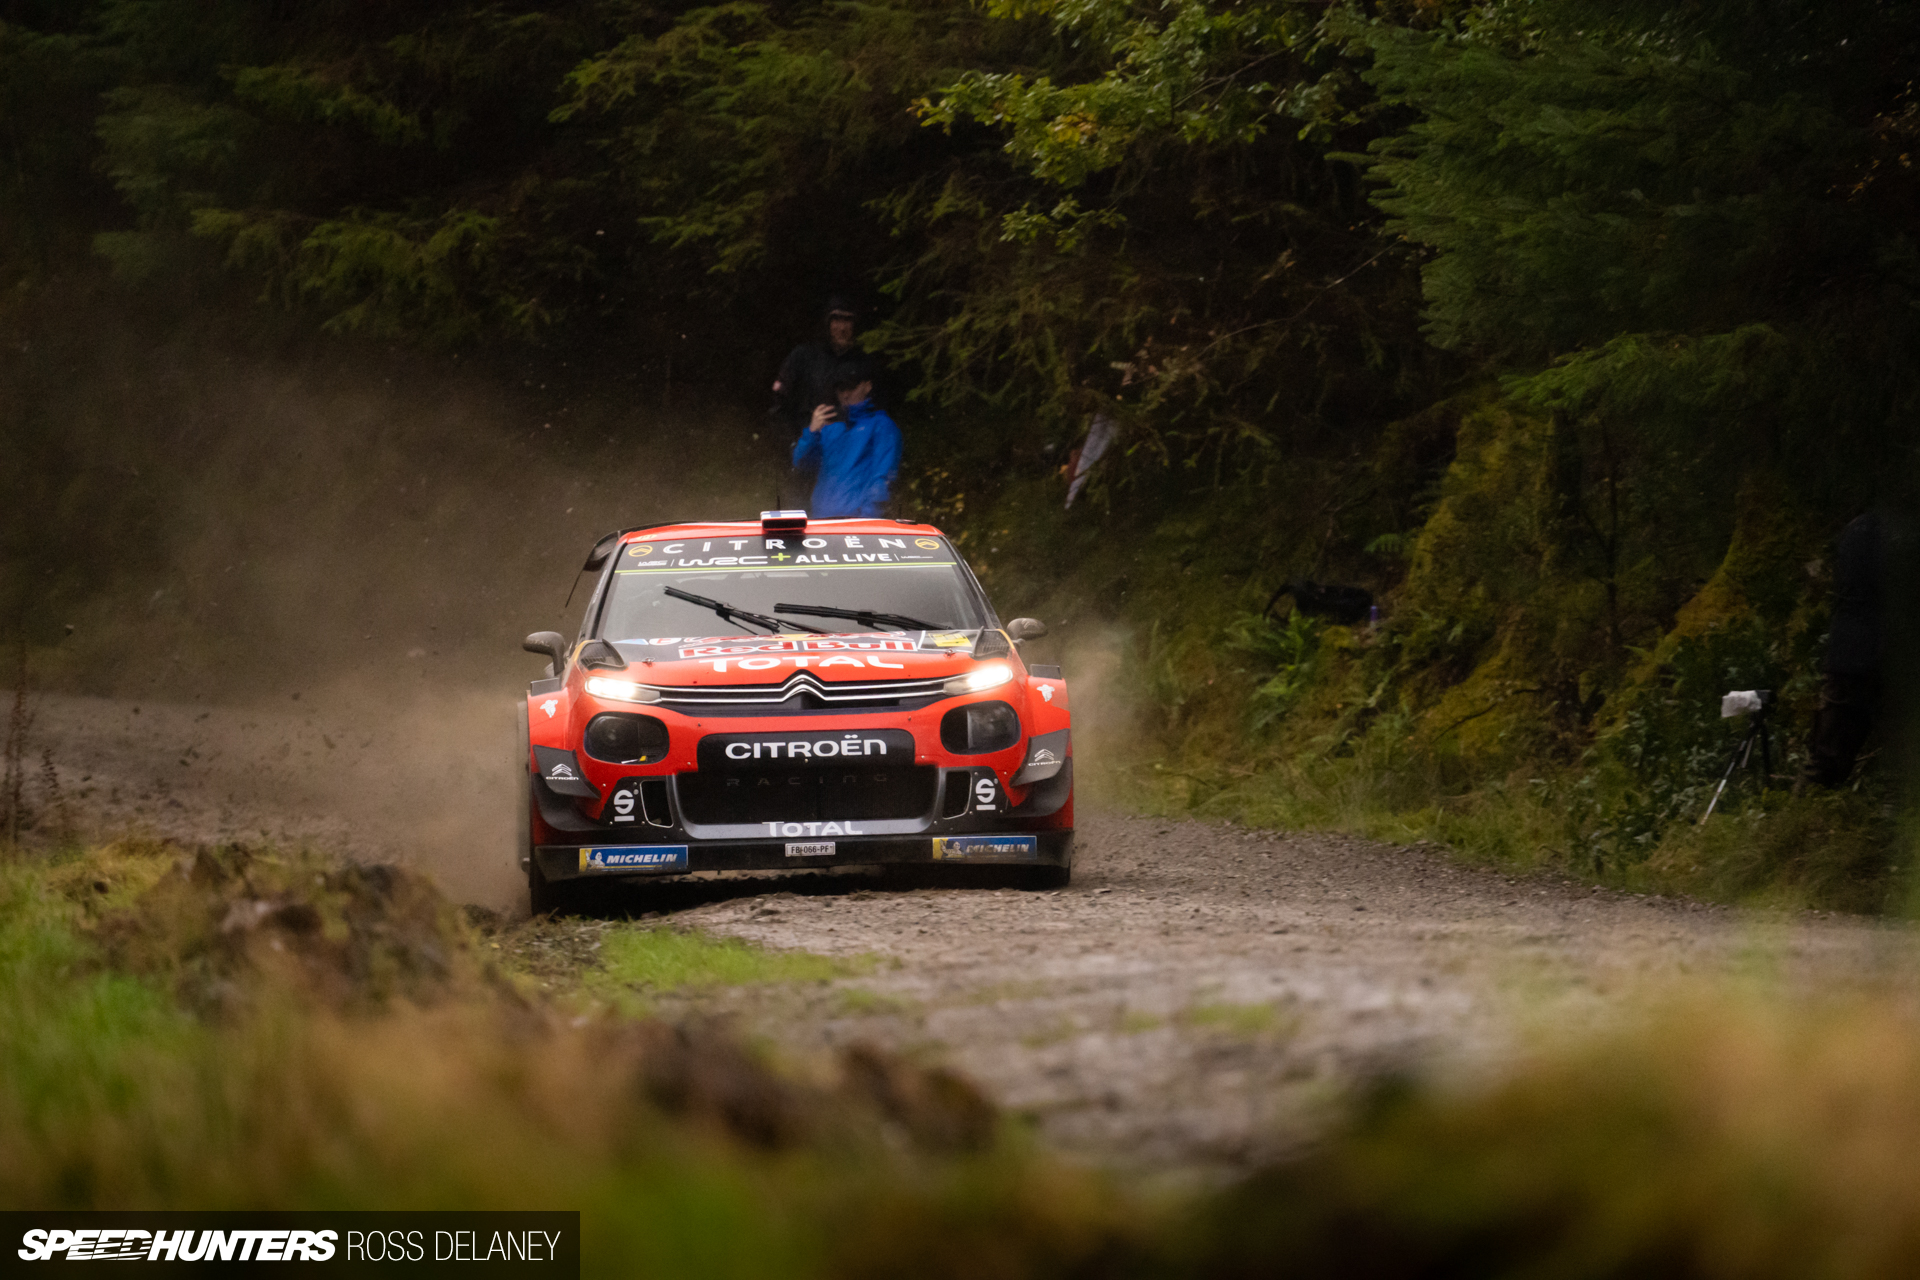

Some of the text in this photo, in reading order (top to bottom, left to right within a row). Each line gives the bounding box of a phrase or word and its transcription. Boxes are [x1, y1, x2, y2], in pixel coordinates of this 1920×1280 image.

[662, 535, 907, 554] CITROËN
[795, 554, 837, 564] ALL
[842, 553, 892, 562] LIVE
[679, 640, 918, 659] Red Bull
[699, 655, 904, 672] TOTAL
[725, 734, 887, 760] CITROËN
[762, 820, 863, 837] TOTAL
[606, 853, 678, 864] MICHELIN
